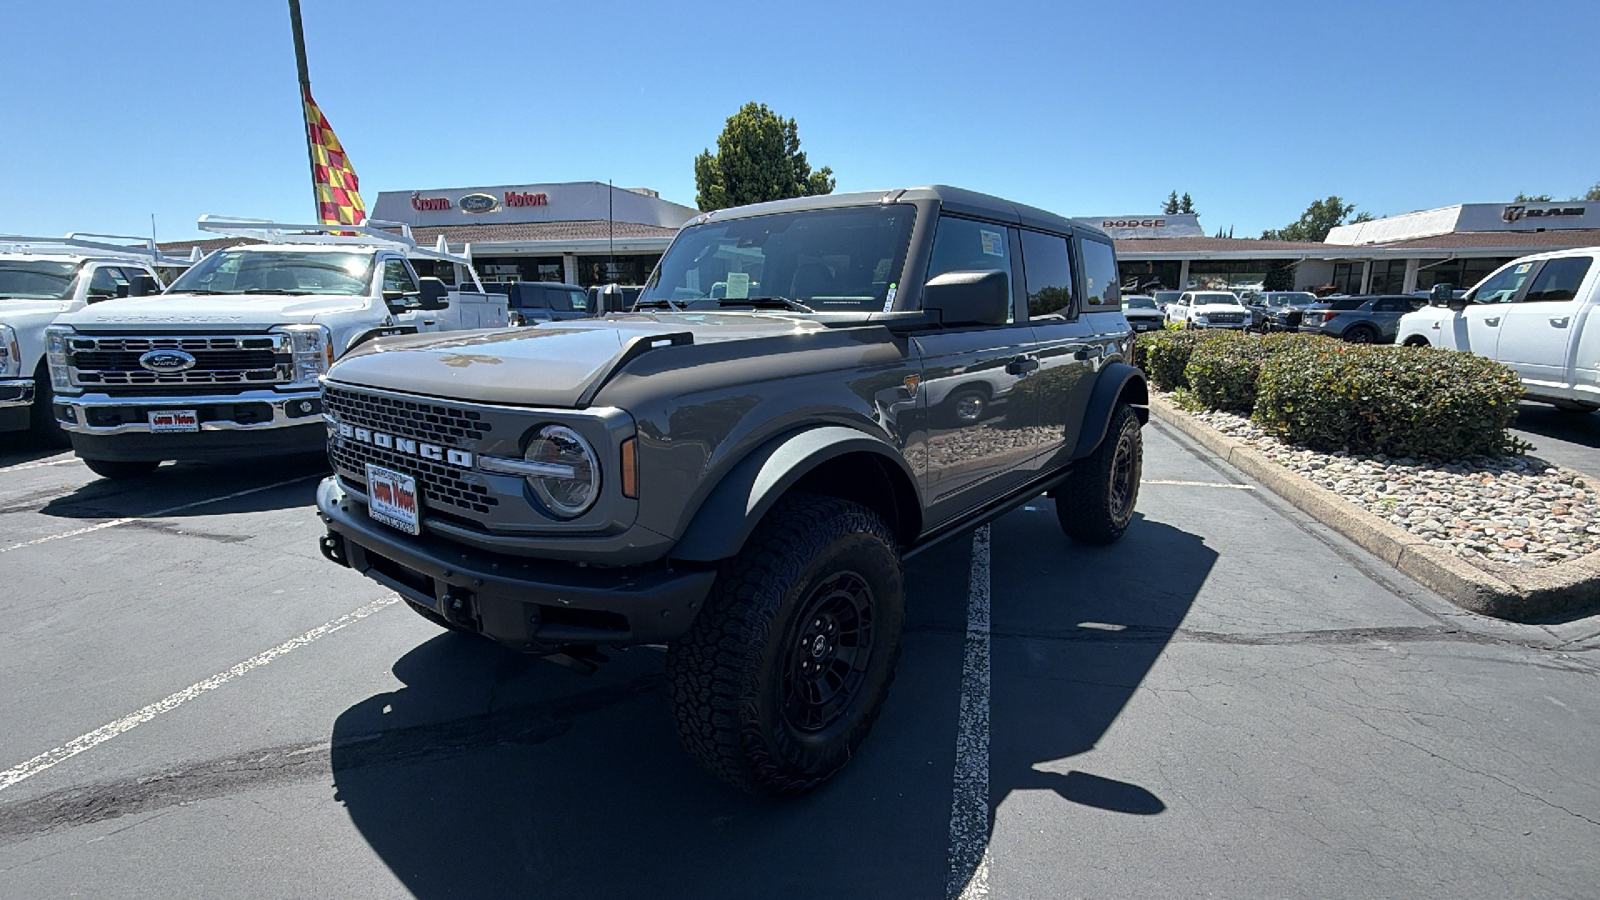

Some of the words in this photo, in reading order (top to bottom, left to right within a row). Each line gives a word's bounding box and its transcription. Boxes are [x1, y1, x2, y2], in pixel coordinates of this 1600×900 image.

[411, 190, 451, 210] Crown
[504, 191, 547, 207] Motors
[466, 199, 487, 209] Ford
[1102, 219, 1166, 228] DODGE
[152, 356, 179, 366] Ford
[338, 423, 472, 467] BRONCO
